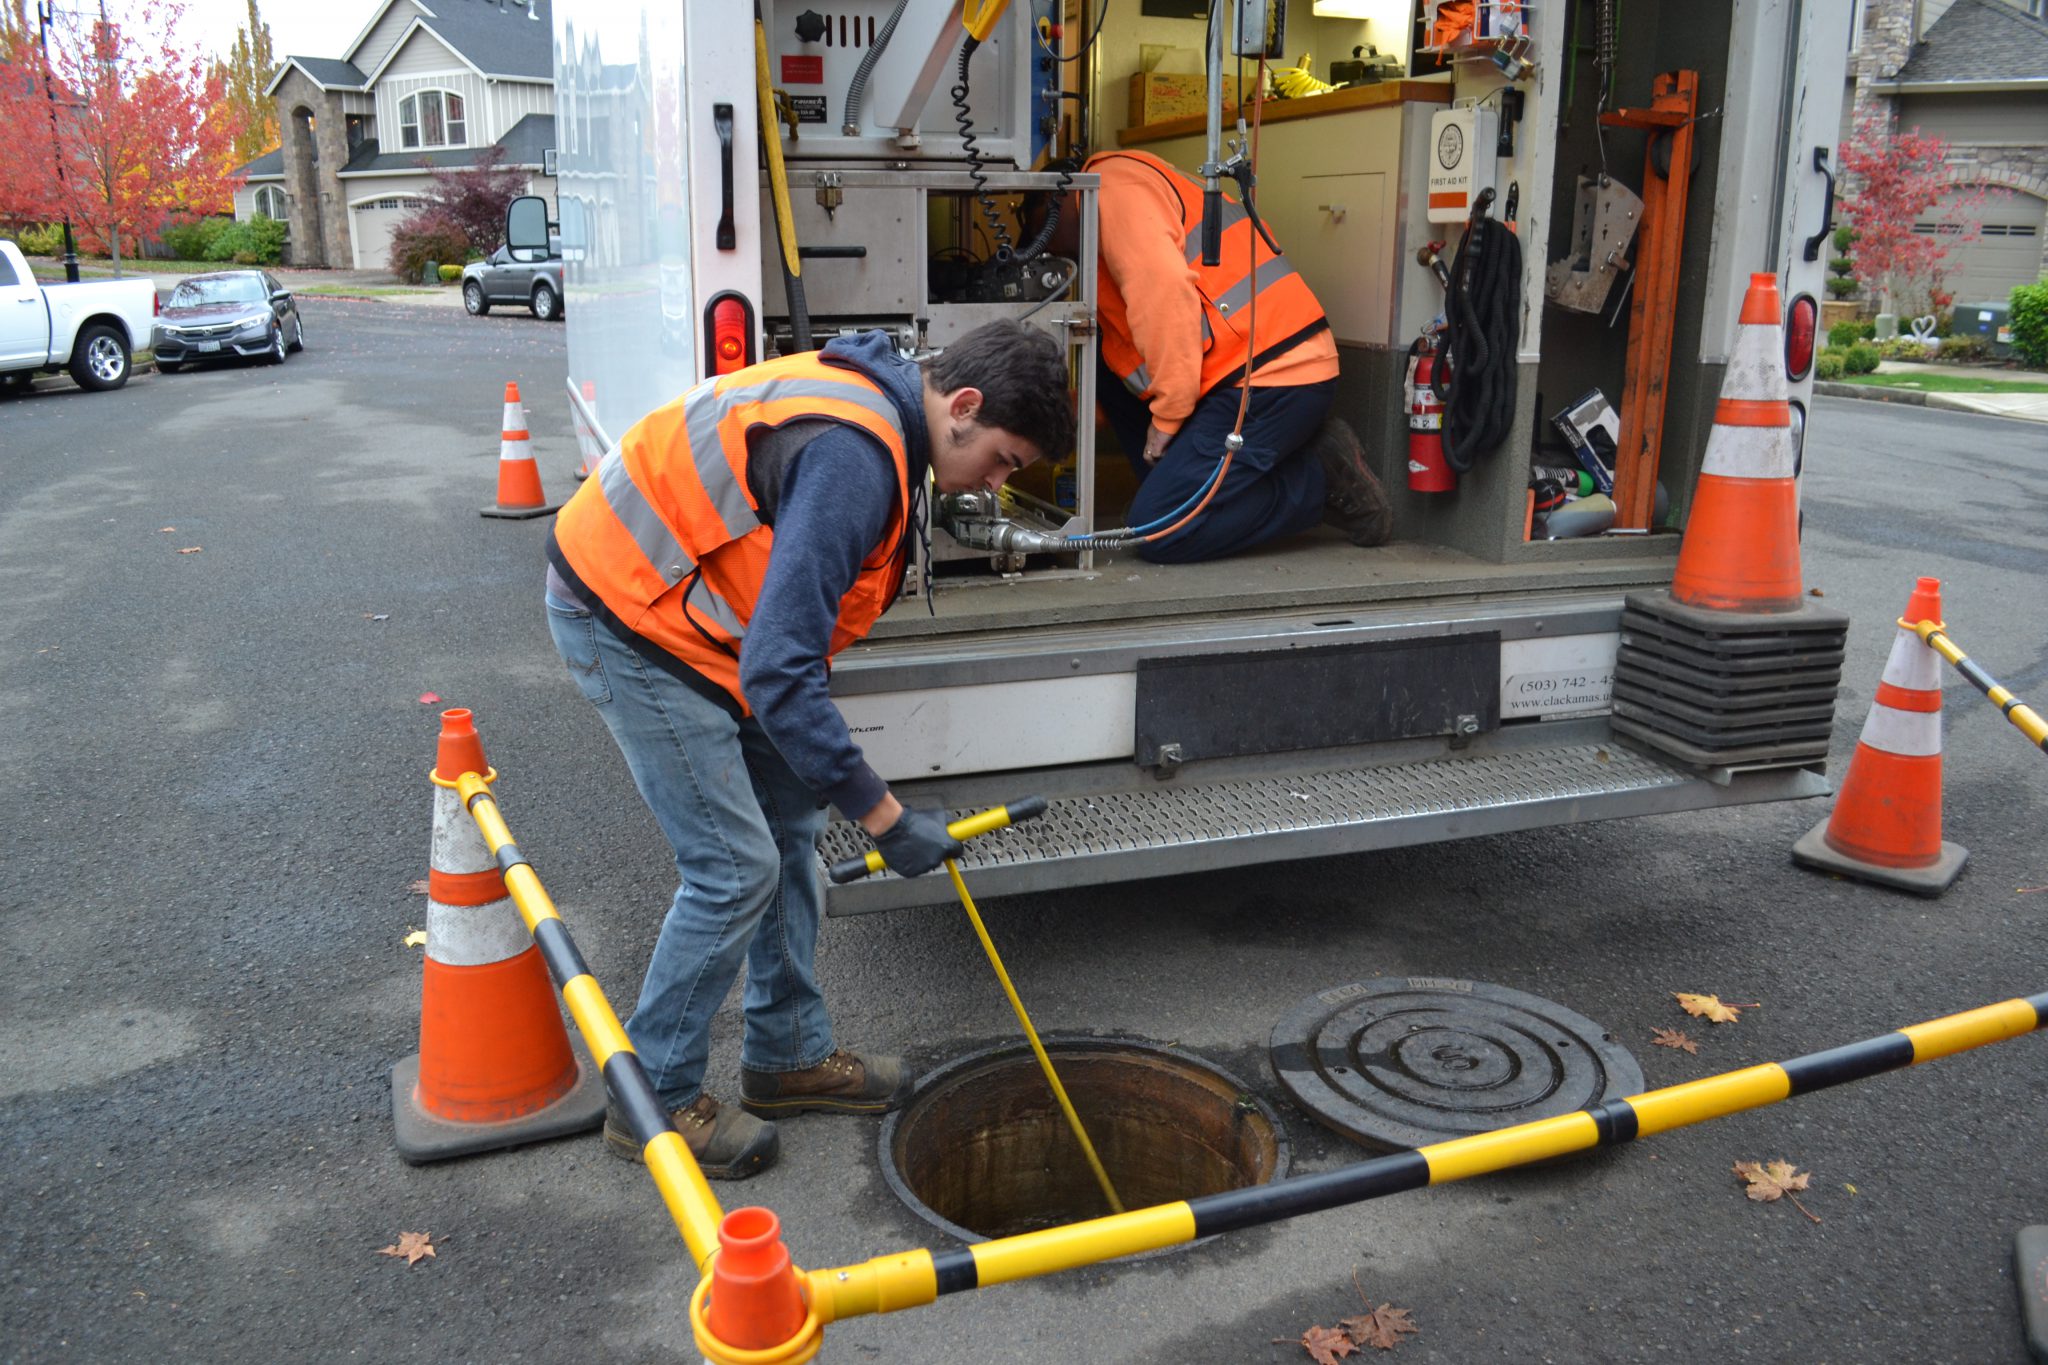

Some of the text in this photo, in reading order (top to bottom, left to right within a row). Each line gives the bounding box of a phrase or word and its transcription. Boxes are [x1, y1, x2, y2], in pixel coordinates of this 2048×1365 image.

[1431, 176, 1468, 186] FIRST AID KIT
[1520, 679, 1557, 694] (503)
[1562, 676, 1586, 689] 742
